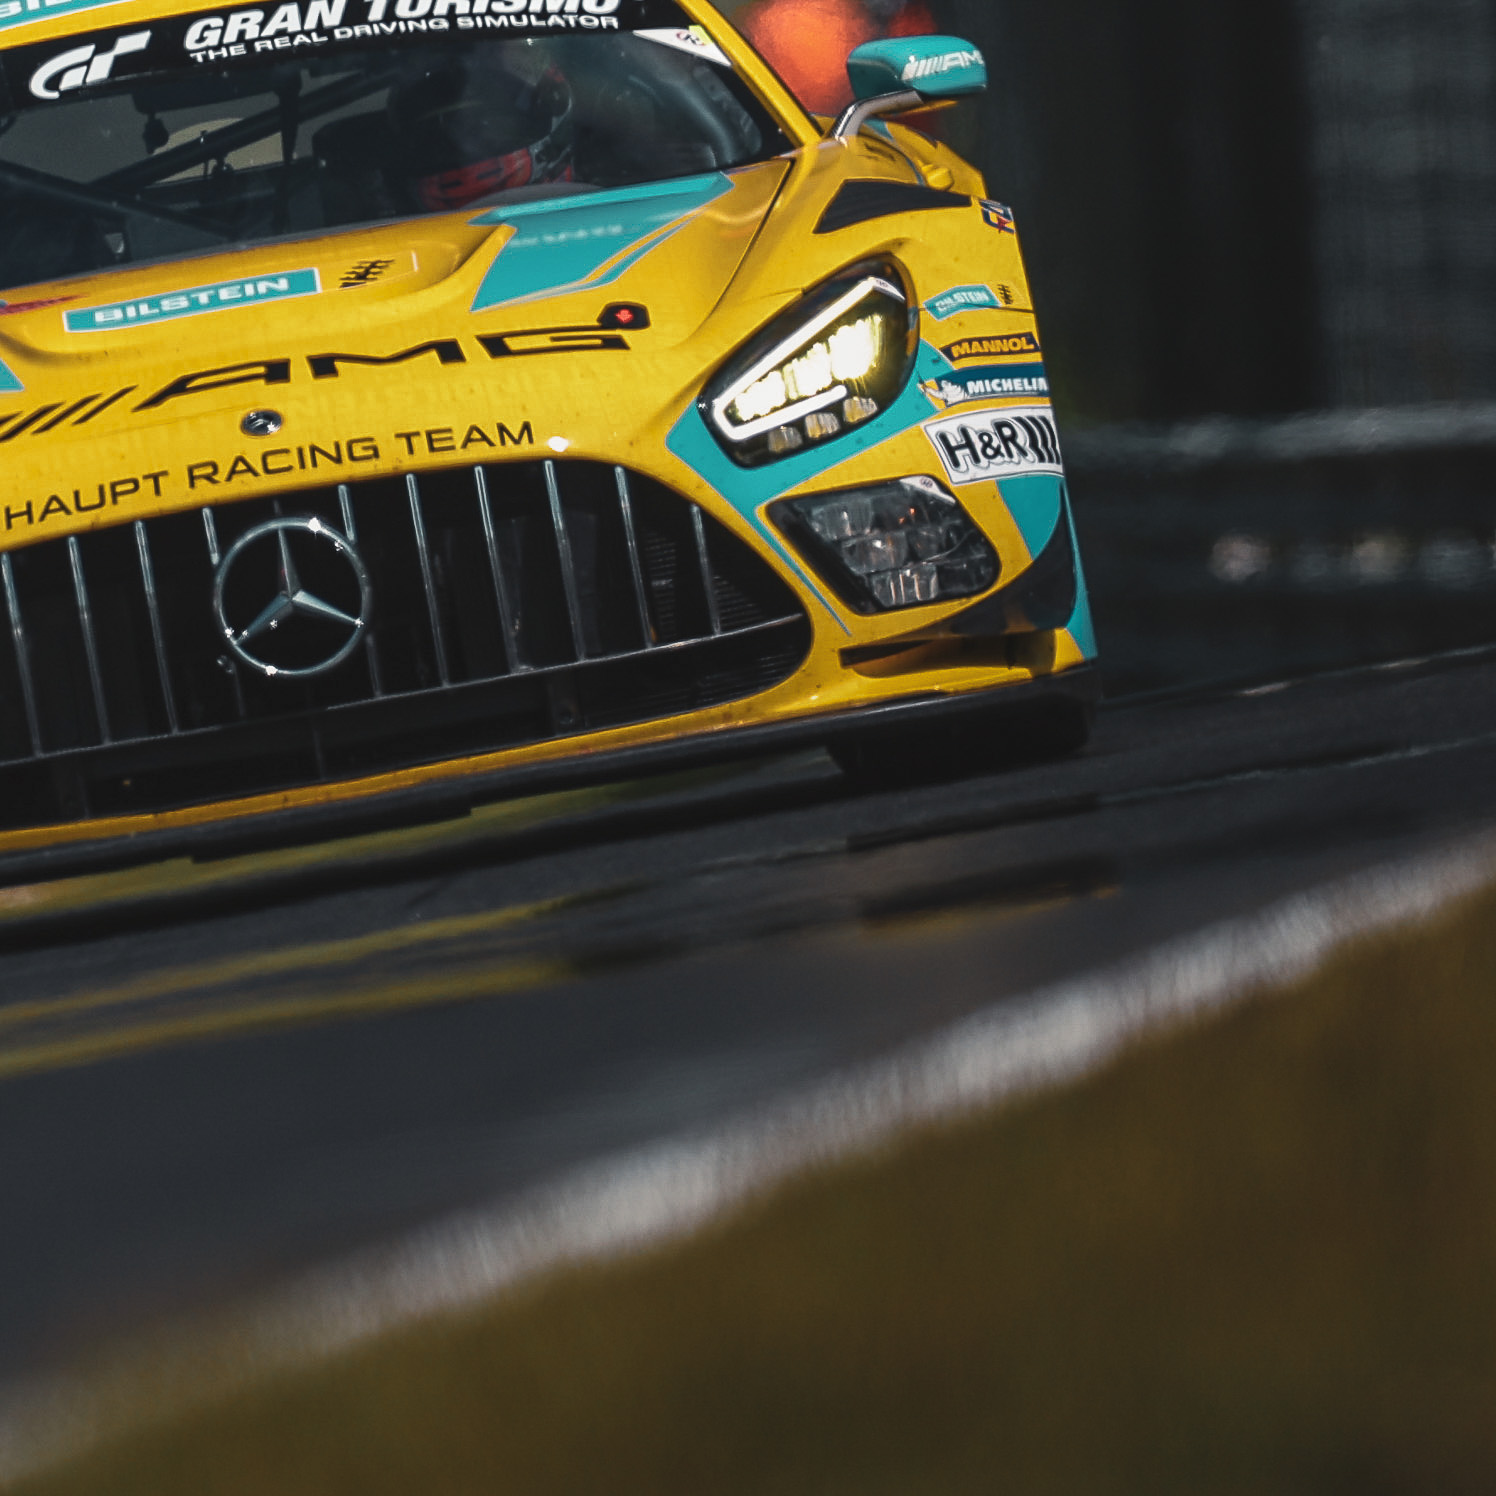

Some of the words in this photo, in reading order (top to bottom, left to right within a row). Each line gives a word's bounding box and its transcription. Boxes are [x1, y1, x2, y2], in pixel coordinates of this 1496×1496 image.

[189, 43, 247, 64] THE
[254, 31, 328, 54] REAL
[334, 17, 450, 40] DRIVING
[457, 14, 619, 30] SIMULATOR
[94, 277, 290, 324] BILSTEIN
[130, 328, 631, 413] AMG
[951, 337, 1035, 358] MANNOL
[966, 377, 1049, 394] MICHELIN
[937, 420, 1029, 468] H&R
[3, 470, 170, 531] HAUPT
[187, 437, 381, 489] RACING
[394, 420, 535, 456] TEAM
